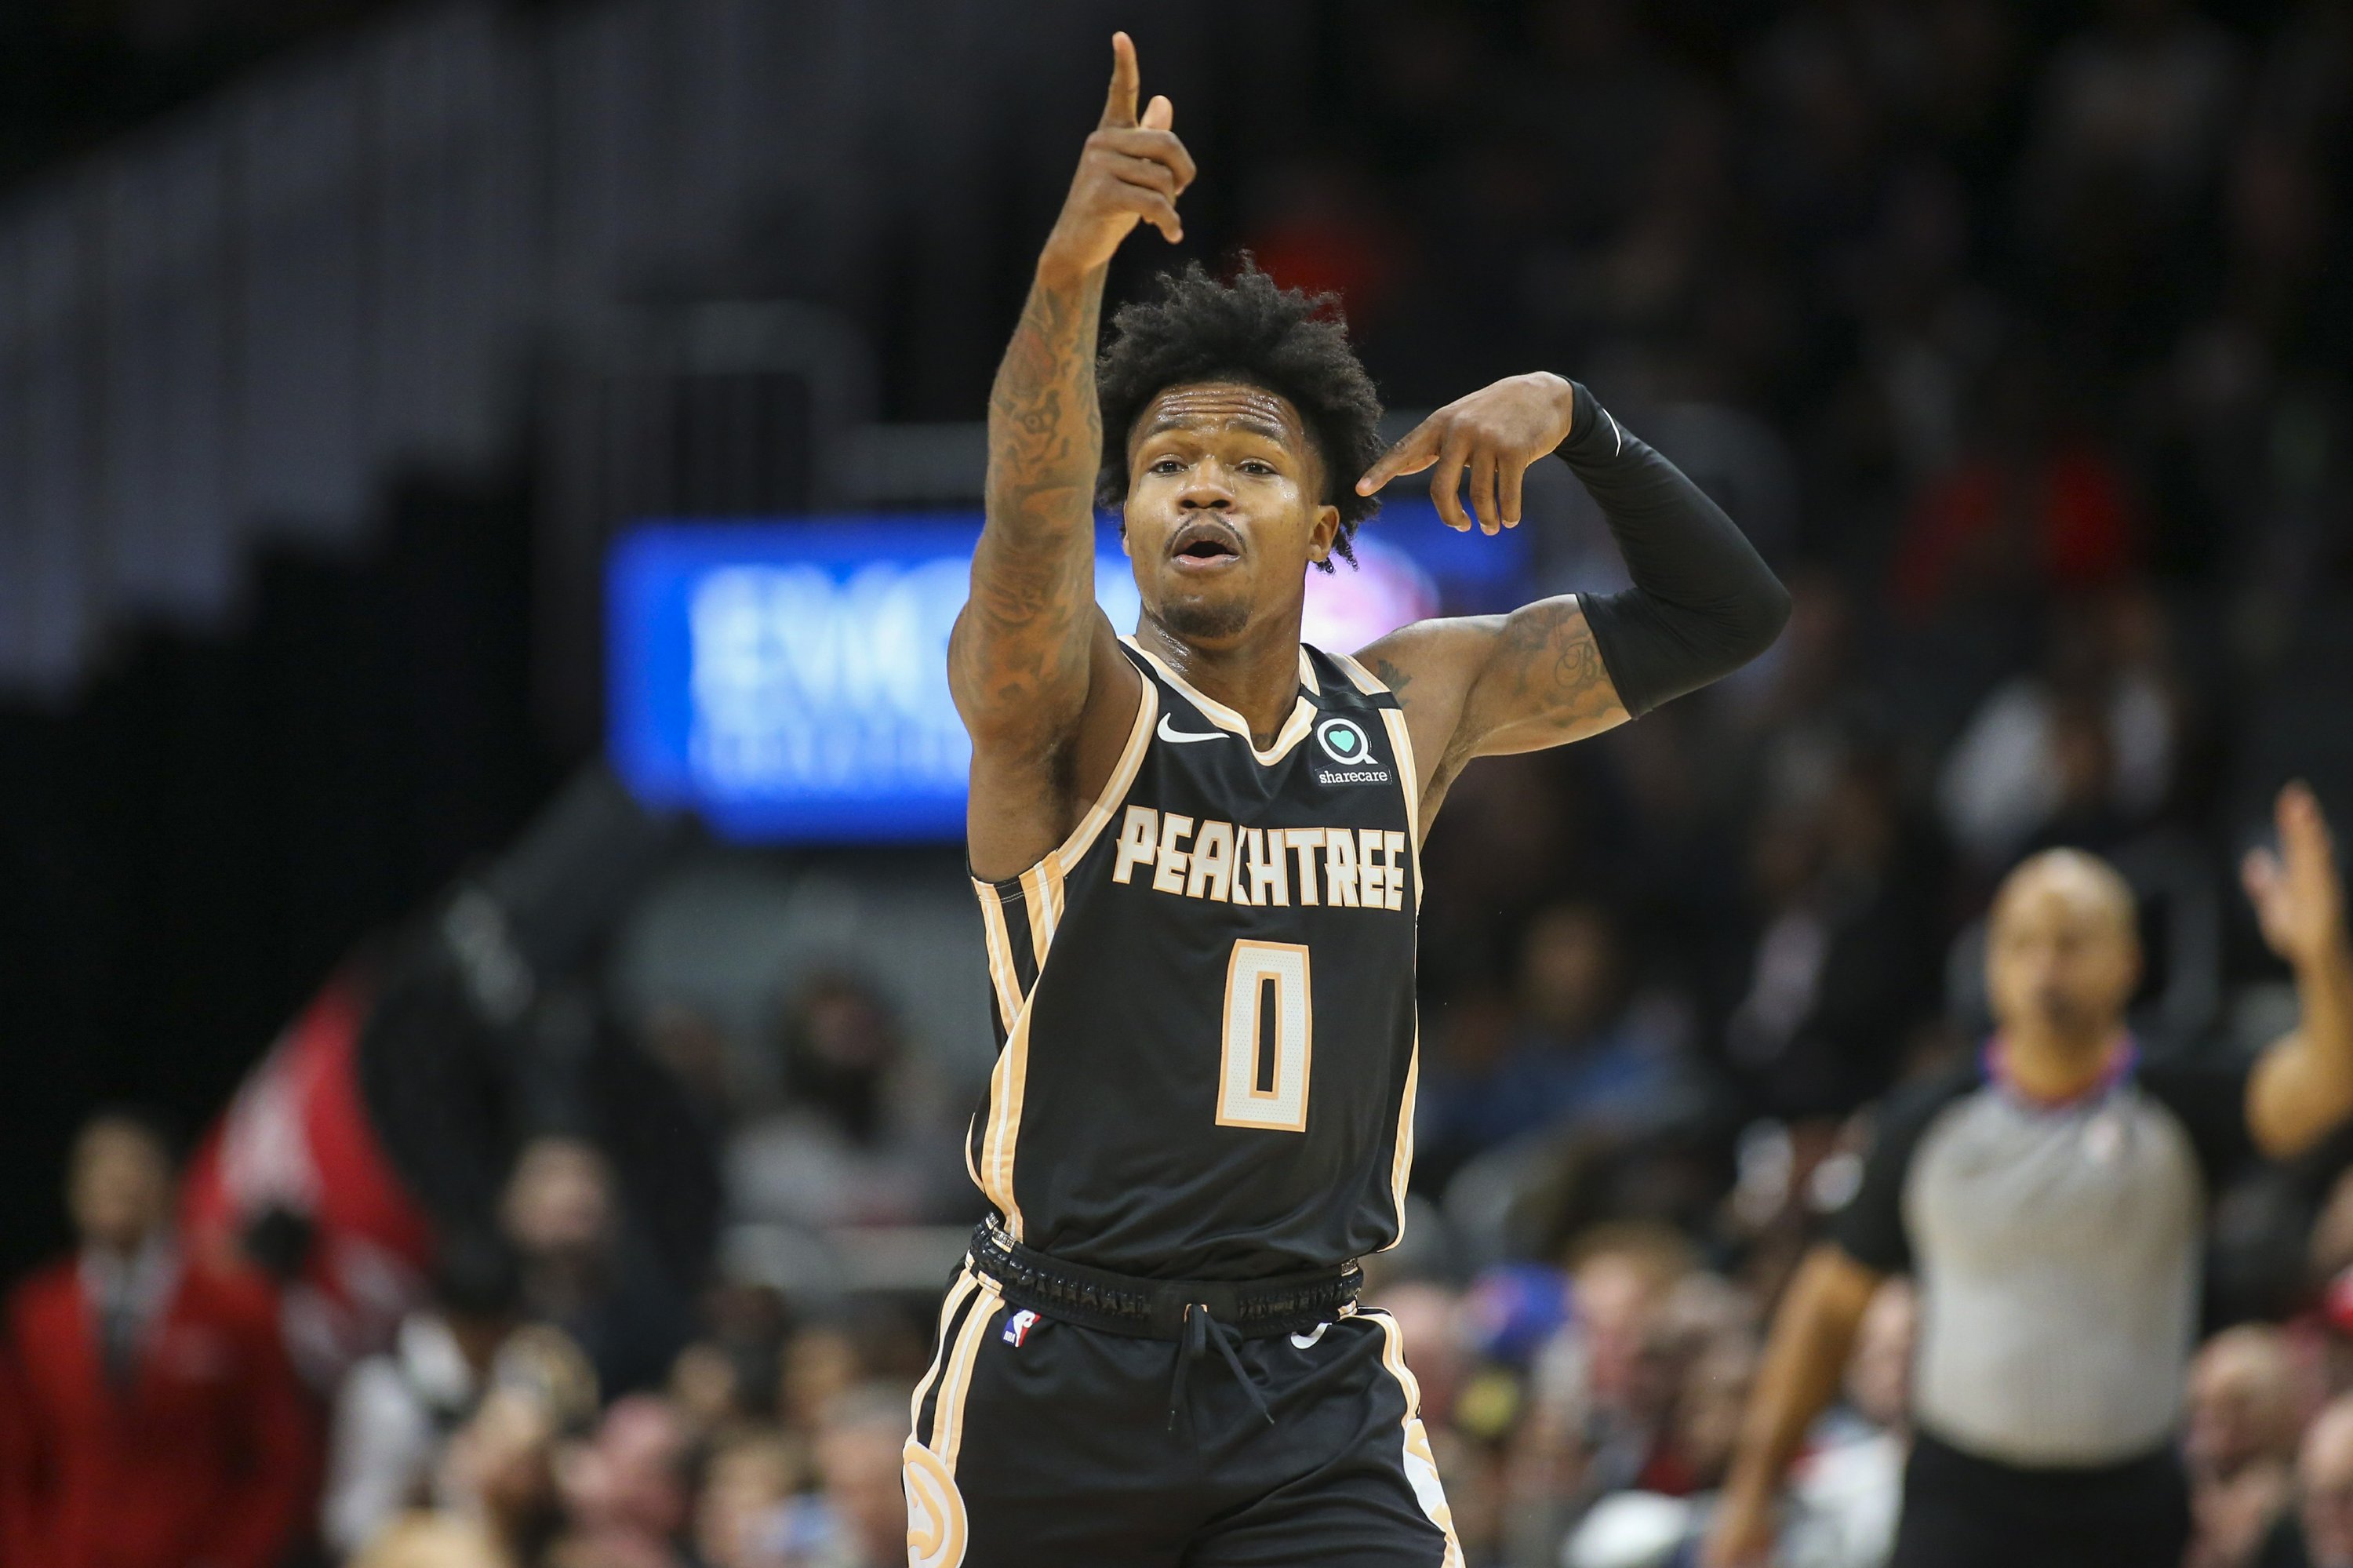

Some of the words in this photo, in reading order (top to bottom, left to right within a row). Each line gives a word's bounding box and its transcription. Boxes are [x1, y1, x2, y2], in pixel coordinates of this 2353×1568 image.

[1318, 770, 1388, 784] sharecare
[1112, 805, 1405, 911] PEACHTREE
[1215, 938, 1313, 1133] 0
[1003, 1330, 1016, 1344] NBA
